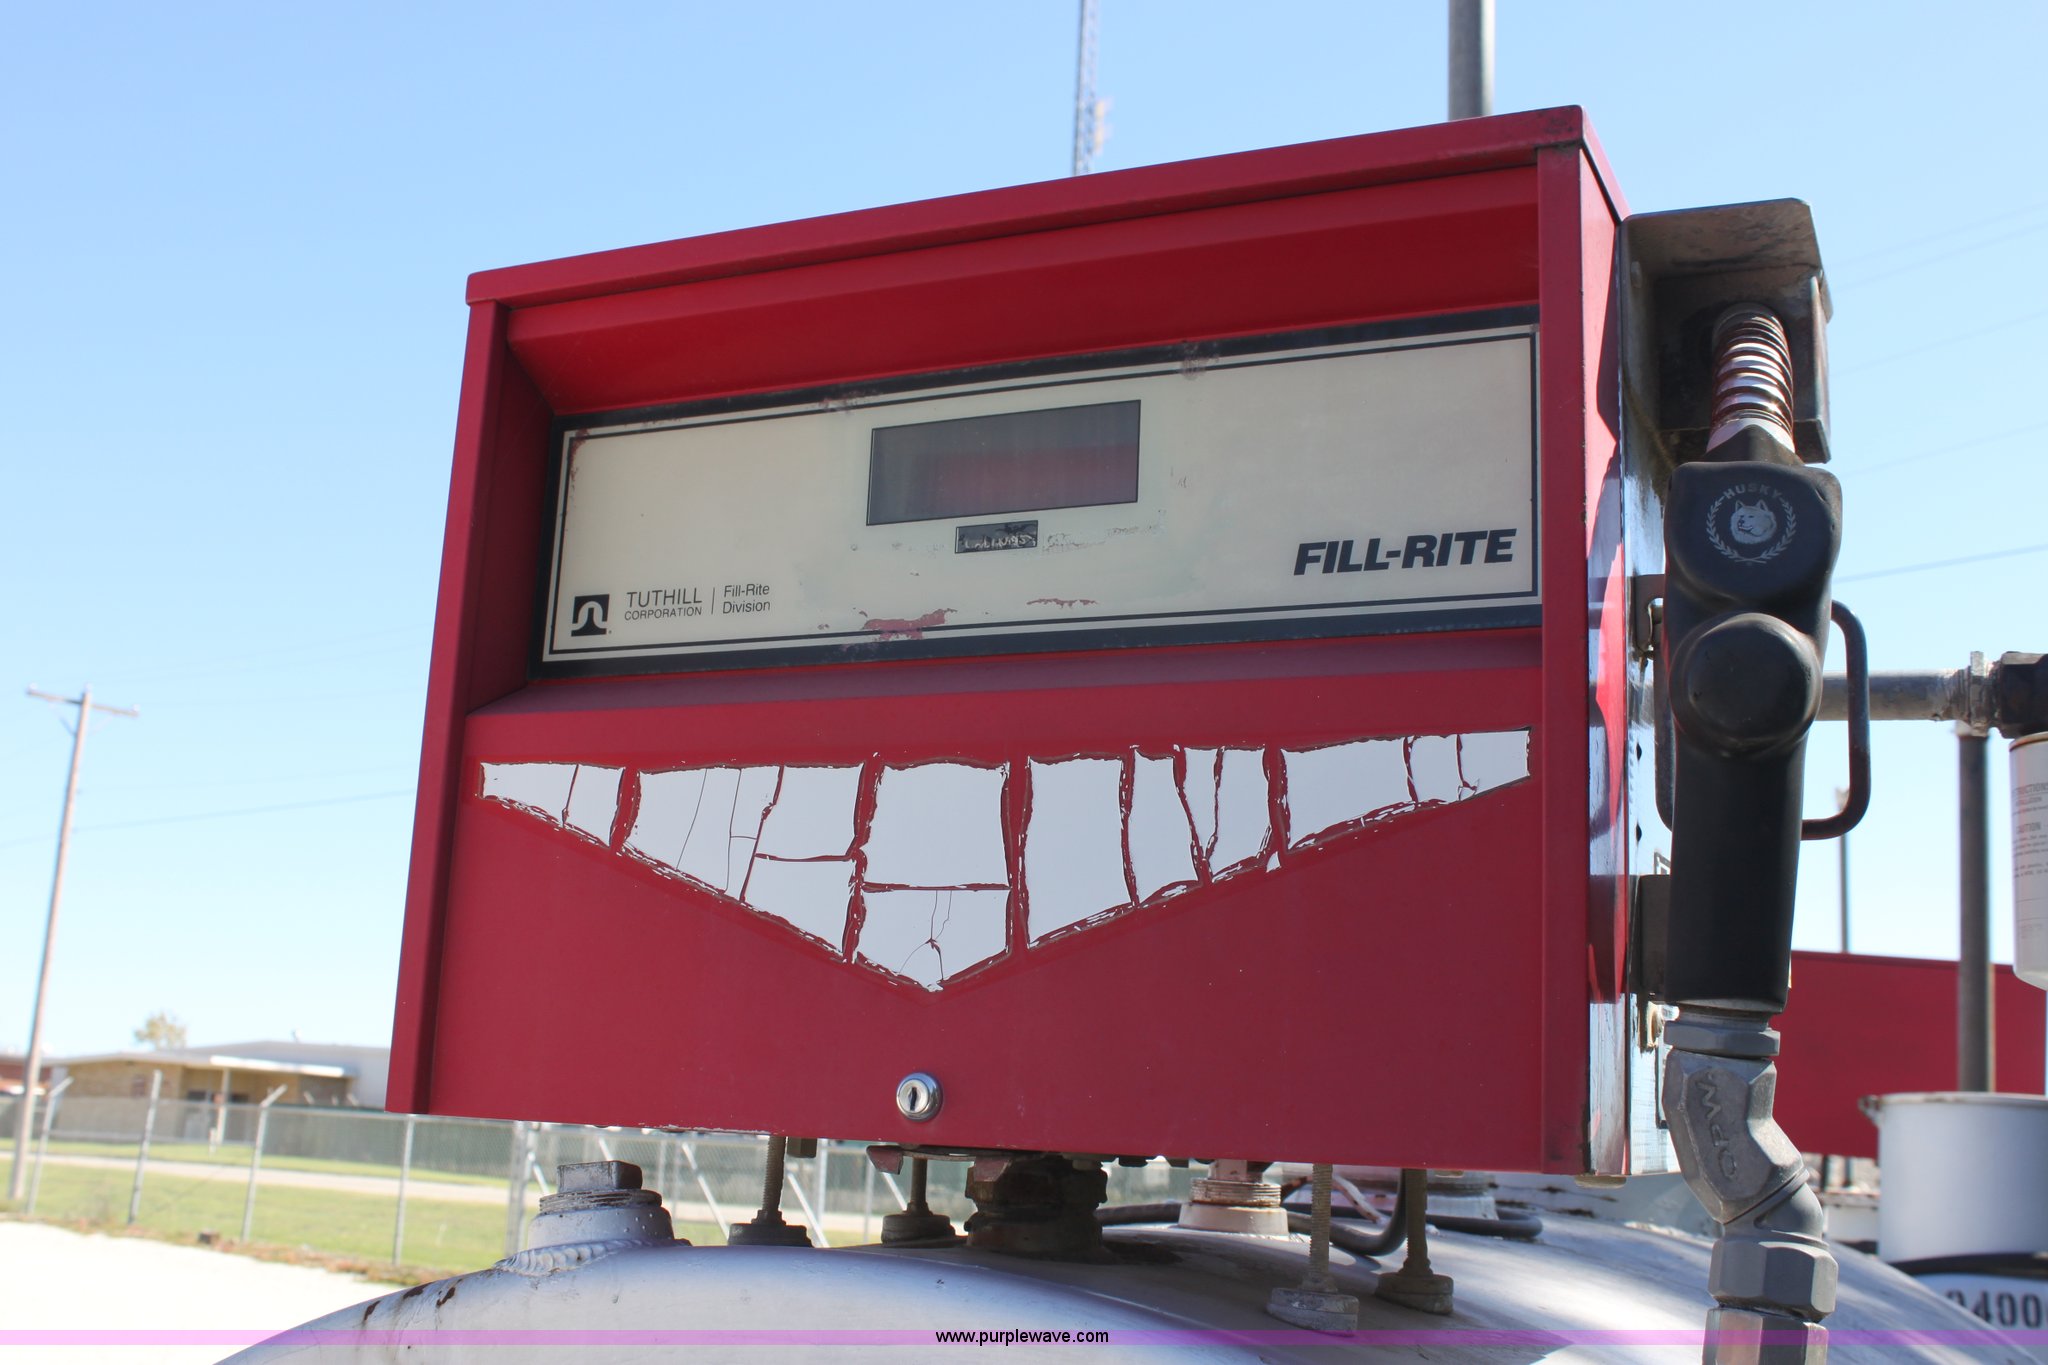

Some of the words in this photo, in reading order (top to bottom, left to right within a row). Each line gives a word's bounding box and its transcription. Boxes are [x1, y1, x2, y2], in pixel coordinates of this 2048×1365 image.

[1723, 482, 1783, 499] HUSKY
[1293, 528, 1517, 576] FILL-RITE
[626, 587, 703, 608] TUTHILL
[723, 583, 770, 598] Fill-Rite
[624, 606, 703, 621] CORPORATION
[722, 598, 771, 614] Division
